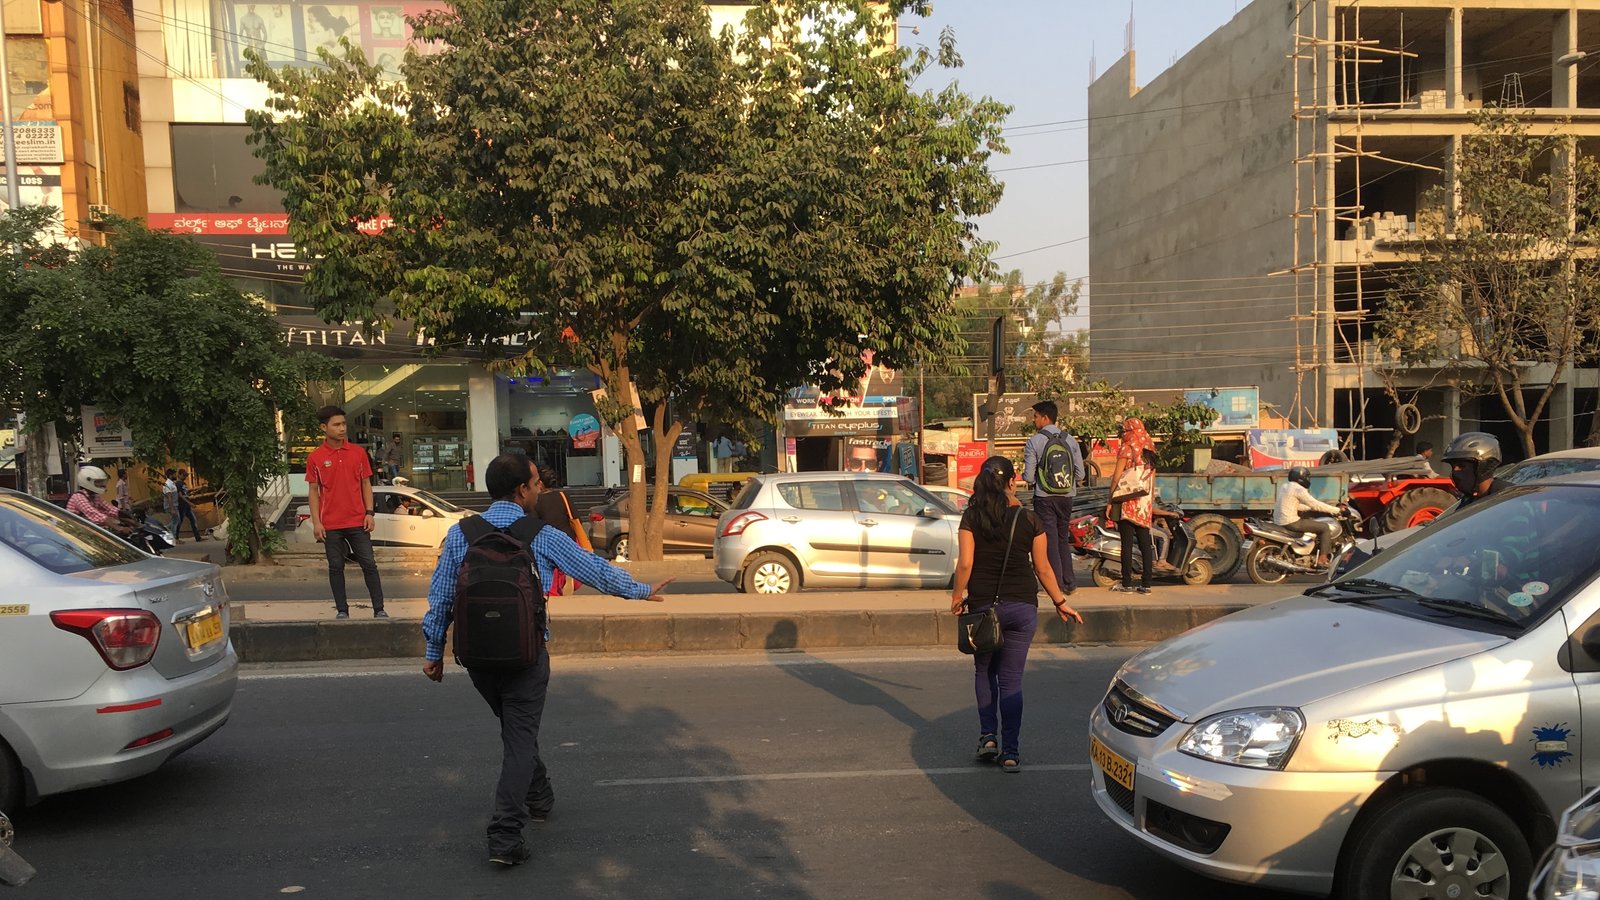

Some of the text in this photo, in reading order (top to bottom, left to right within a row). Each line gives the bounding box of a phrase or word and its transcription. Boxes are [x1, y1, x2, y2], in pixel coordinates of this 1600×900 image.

[20, 177, 43, 185] LOSS
[356, 220, 378, 230] ARE
[299, 329, 386, 346] TITAN
[837, 421, 880, 431] eyeplus
[848, 437, 891, 447] fastrack
[0, 605, 27, 614] 2558
